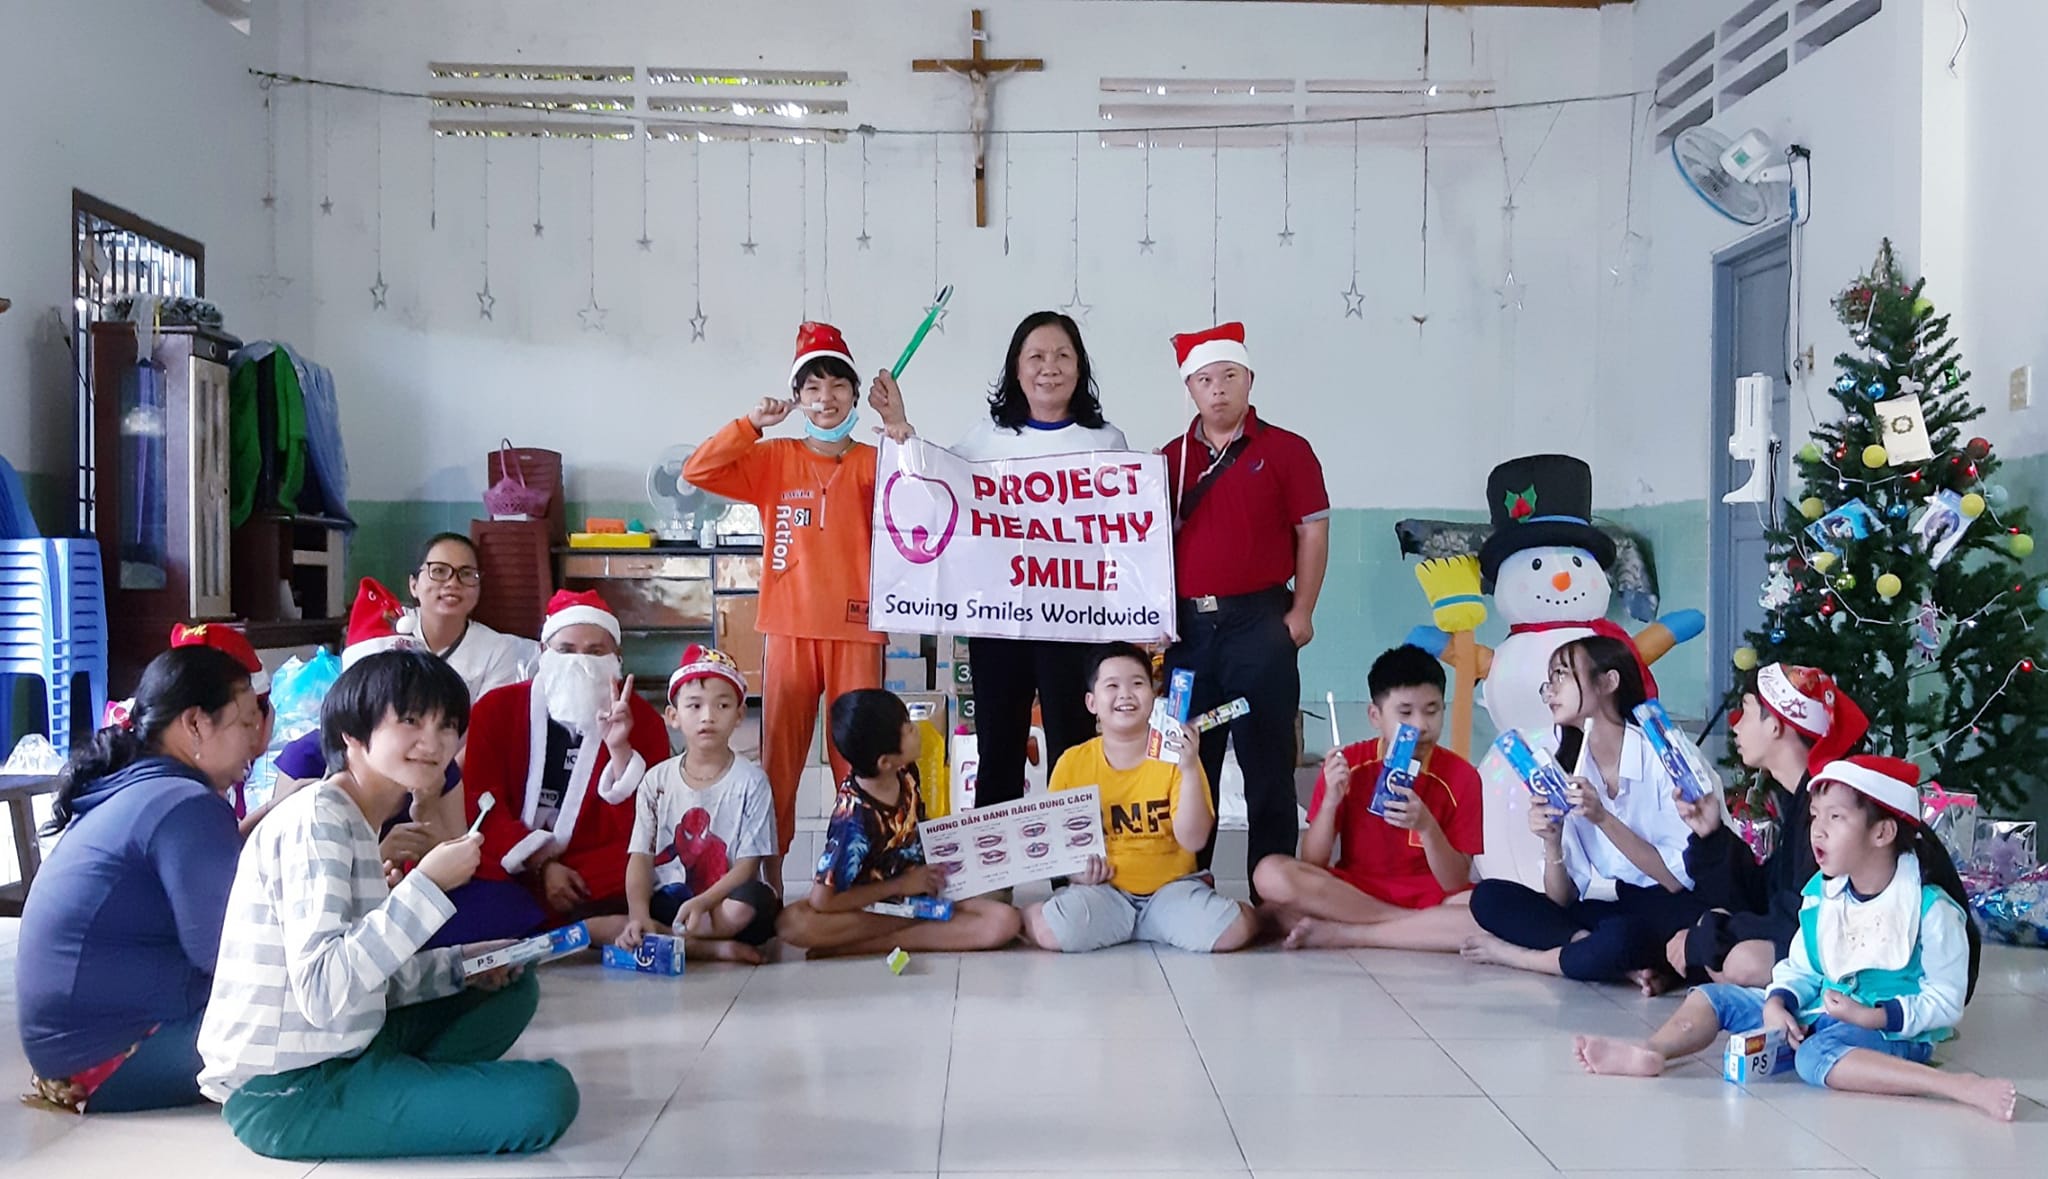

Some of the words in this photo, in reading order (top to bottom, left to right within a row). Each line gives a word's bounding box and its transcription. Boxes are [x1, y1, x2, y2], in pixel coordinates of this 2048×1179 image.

[972, 463, 1142, 505] PROJECT
[772, 504, 793, 571] Action
[971, 509, 1153, 544] HEALTHY
[1010, 554, 1118, 591] SMILE
[885, 595, 958, 620] Saving
[966, 599, 1033, 623] Smiles
[1041, 603, 1160, 626] Worldwide
[1101, 799, 1170, 835] NF
